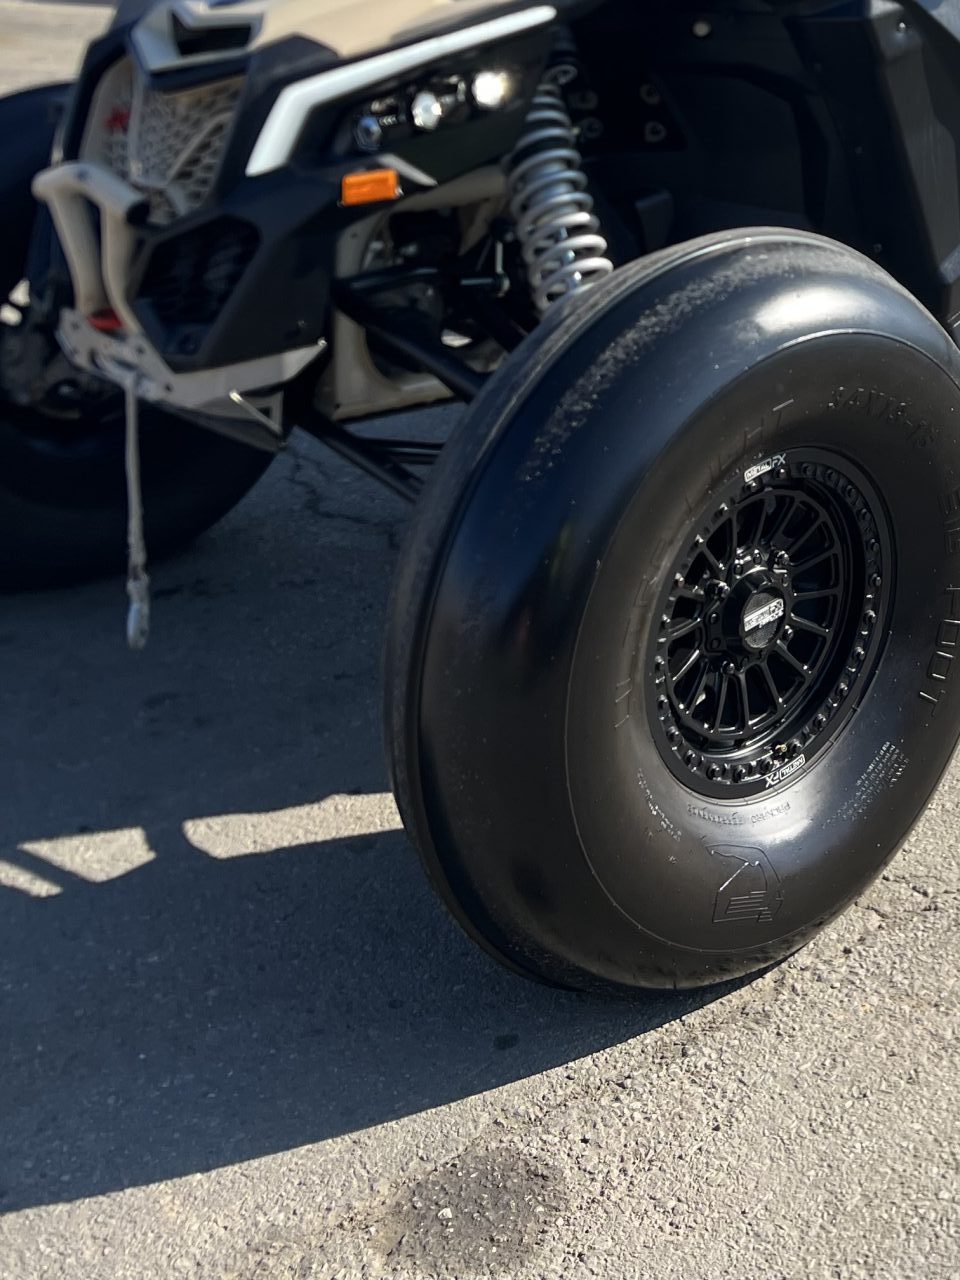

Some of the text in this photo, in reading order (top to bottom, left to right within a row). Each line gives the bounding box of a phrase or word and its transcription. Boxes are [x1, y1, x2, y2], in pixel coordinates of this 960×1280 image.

[772, 453, 787, 468] FX
[765, 753, 806, 788] METAL FX
